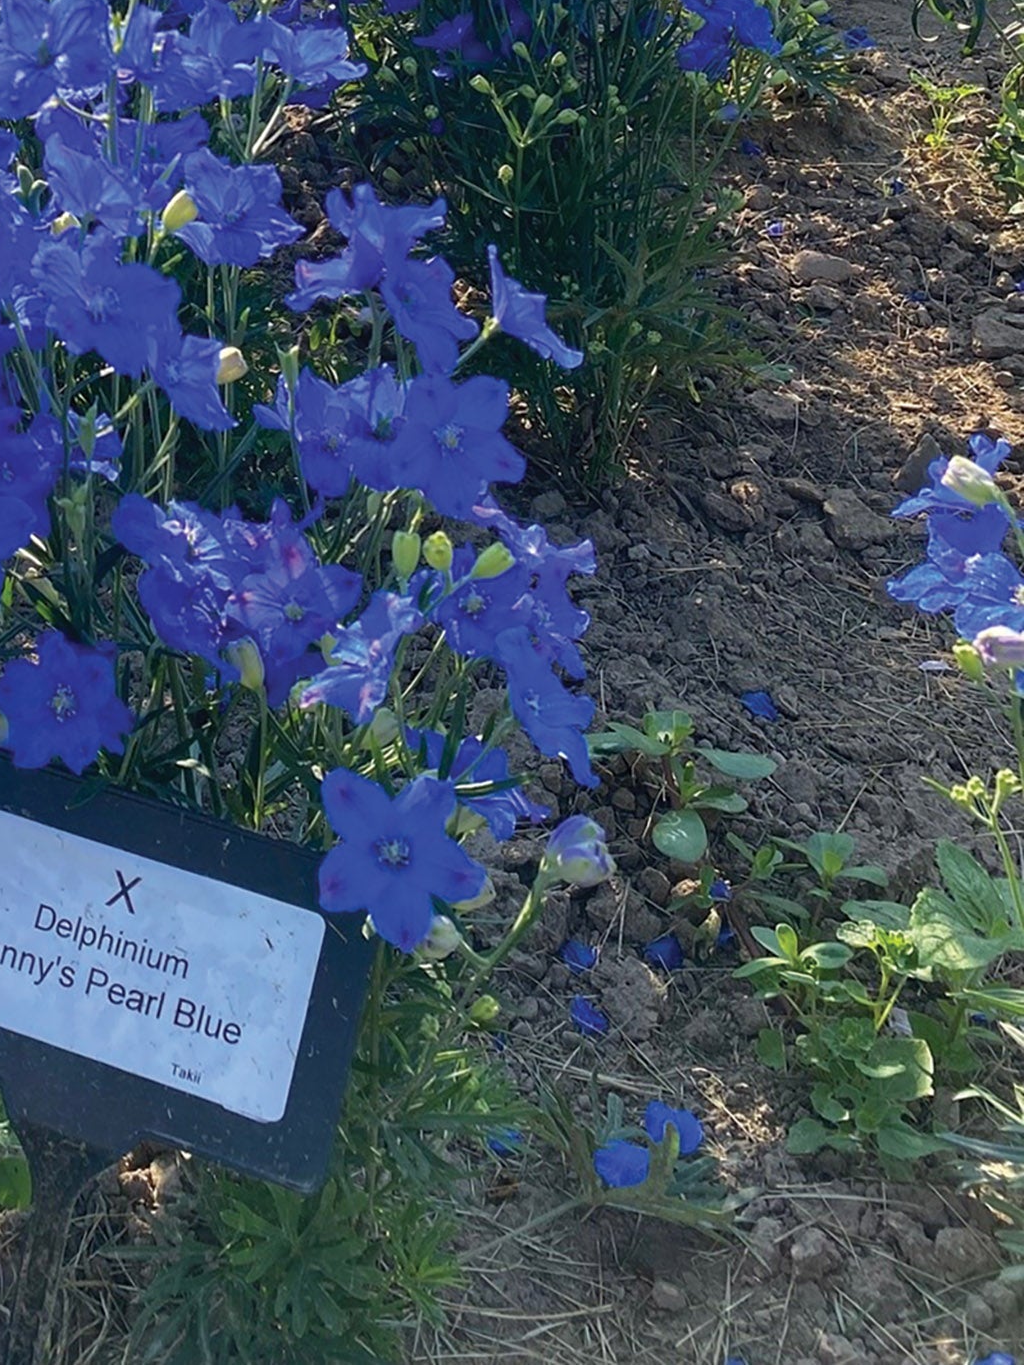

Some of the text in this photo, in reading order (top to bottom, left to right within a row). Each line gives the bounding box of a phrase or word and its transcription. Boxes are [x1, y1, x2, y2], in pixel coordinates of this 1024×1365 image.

[105, 870, 142, 914] X
[34, 904, 189, 979] Delphinium
[85, 967, 165, 1019] Pearl
[173, 997, 242, 1045] Blue
[171, 1063, 201, 1084] Takii
